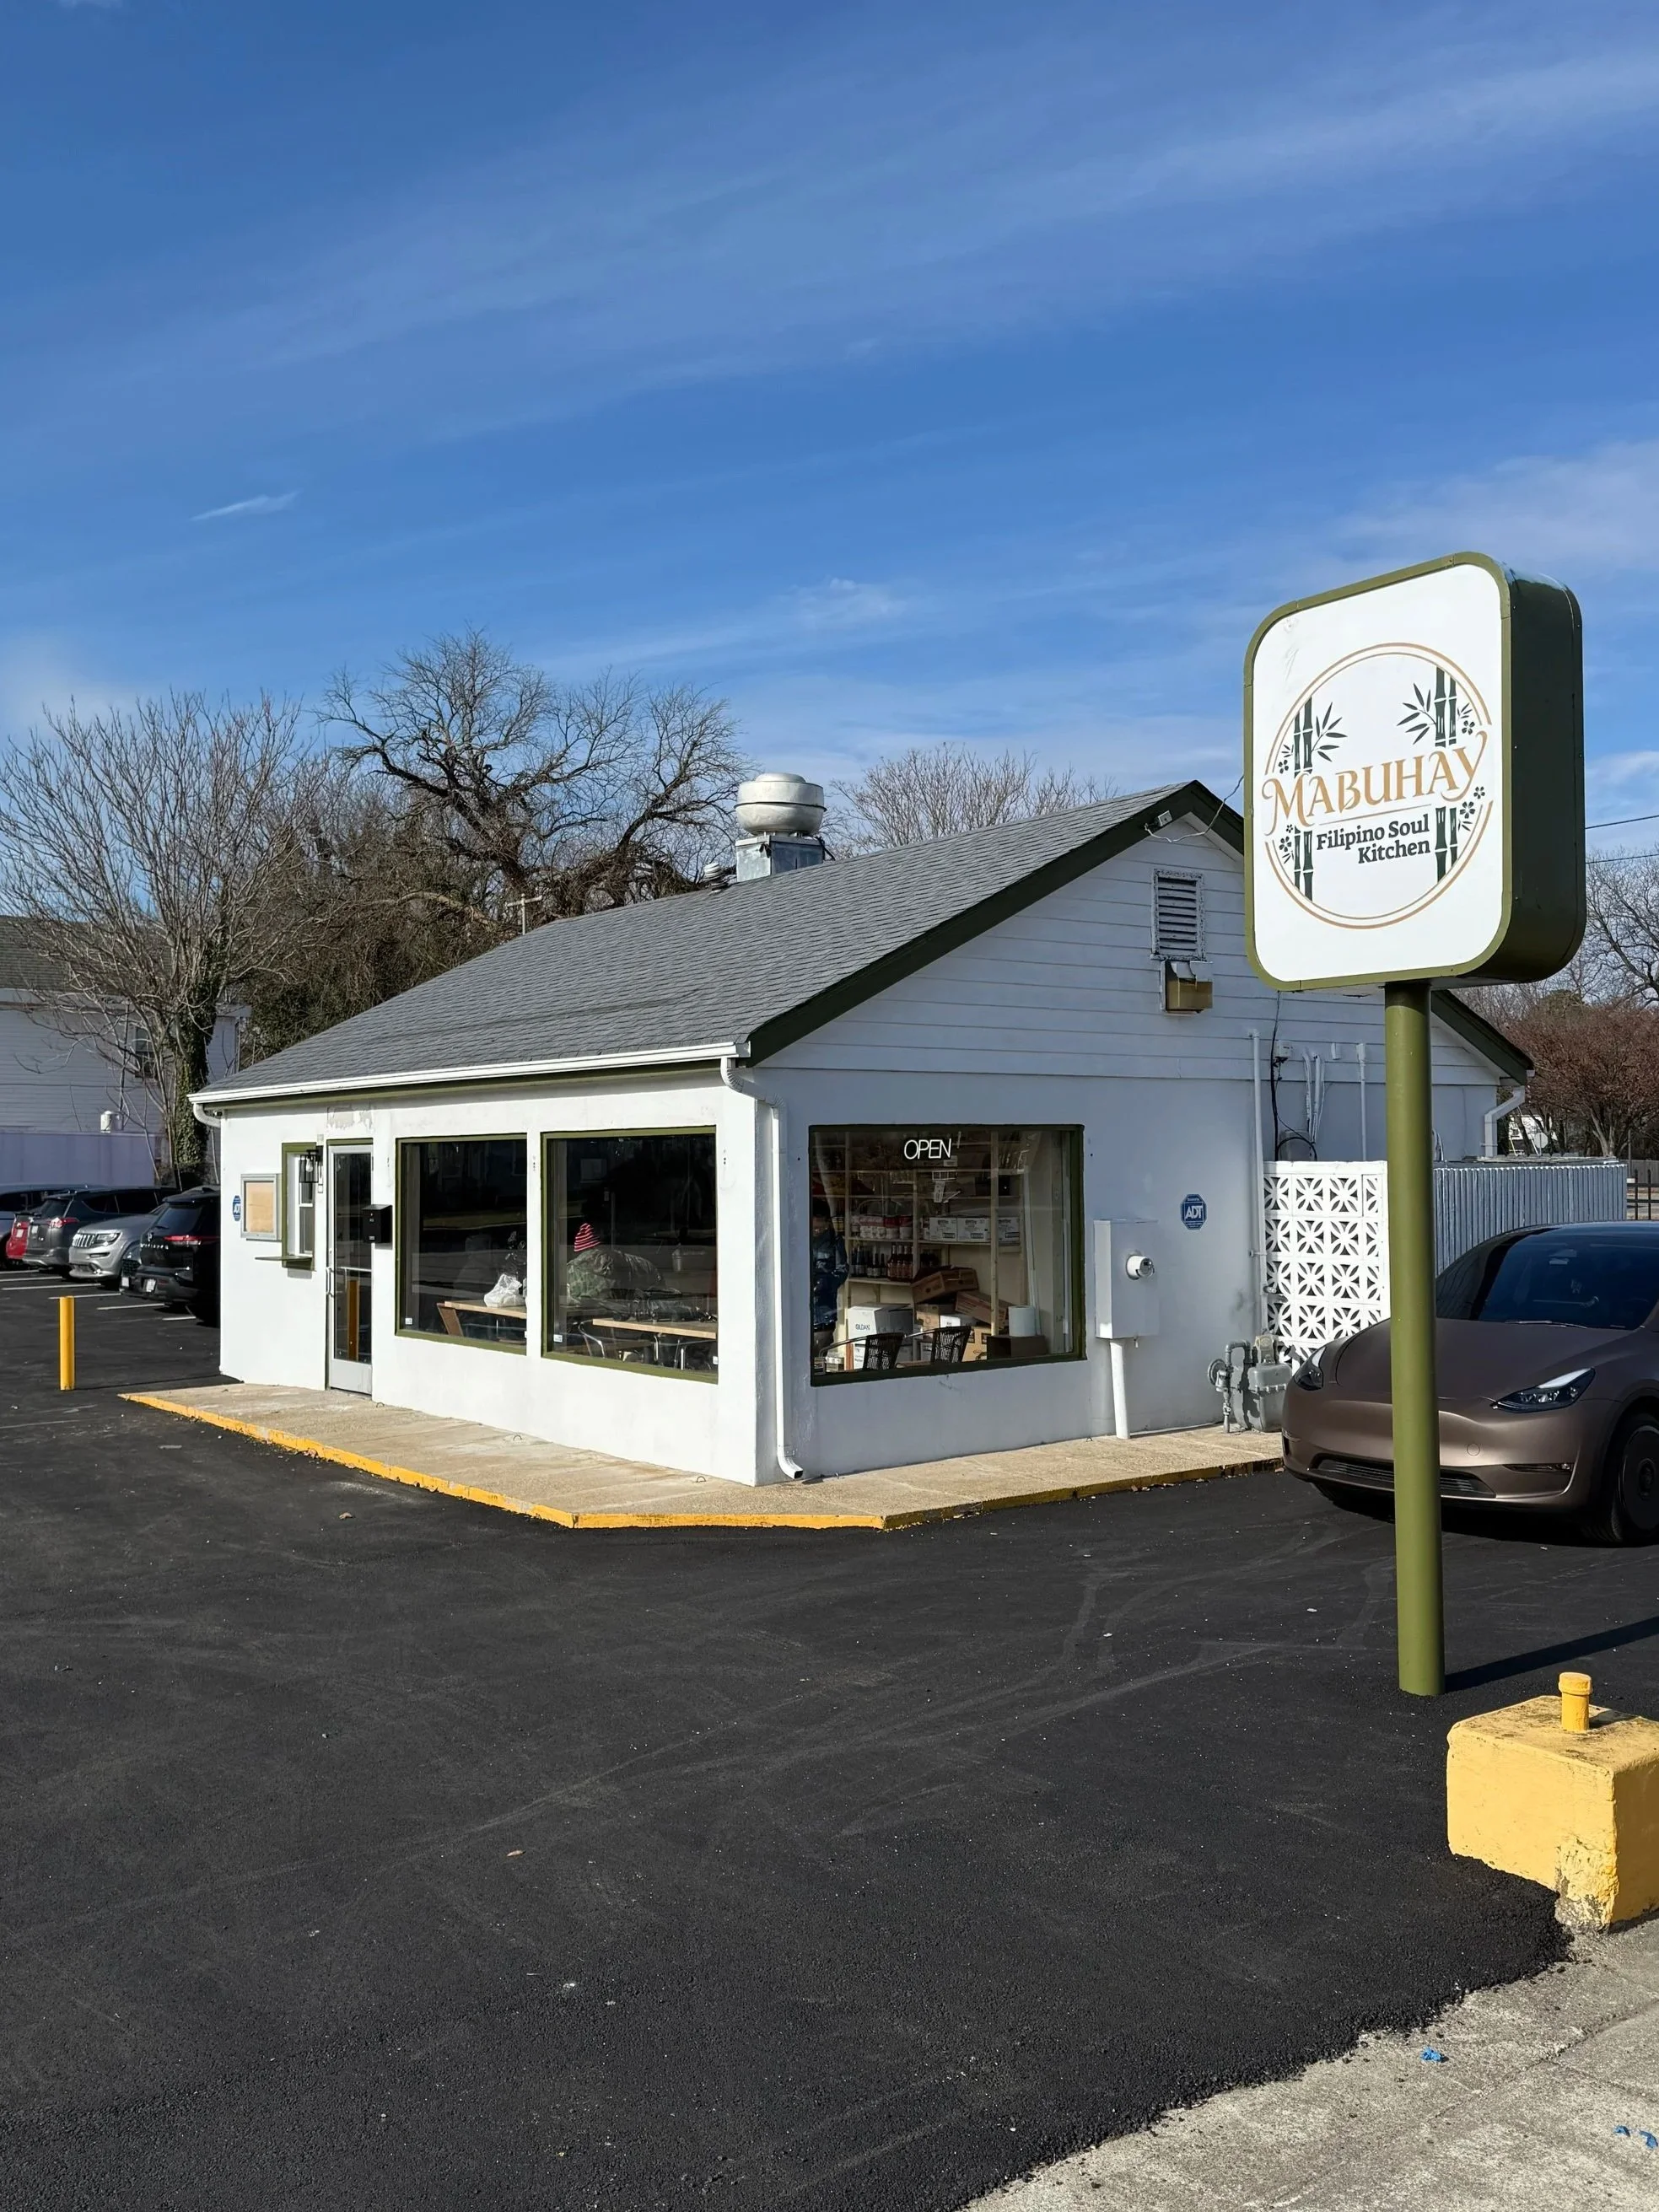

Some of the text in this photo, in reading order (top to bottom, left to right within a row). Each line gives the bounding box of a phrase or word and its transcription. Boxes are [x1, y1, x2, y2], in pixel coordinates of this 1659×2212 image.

[1262, 730, 1488, 836] MABUHAY
[1317, 814, 1430, 850] Filipino Soul
[1358, 839, 1430, 864] Kitchen
[903, 1138, 951, 1160] OPEN
[1184, 1205, 1204, 1219] ADT
